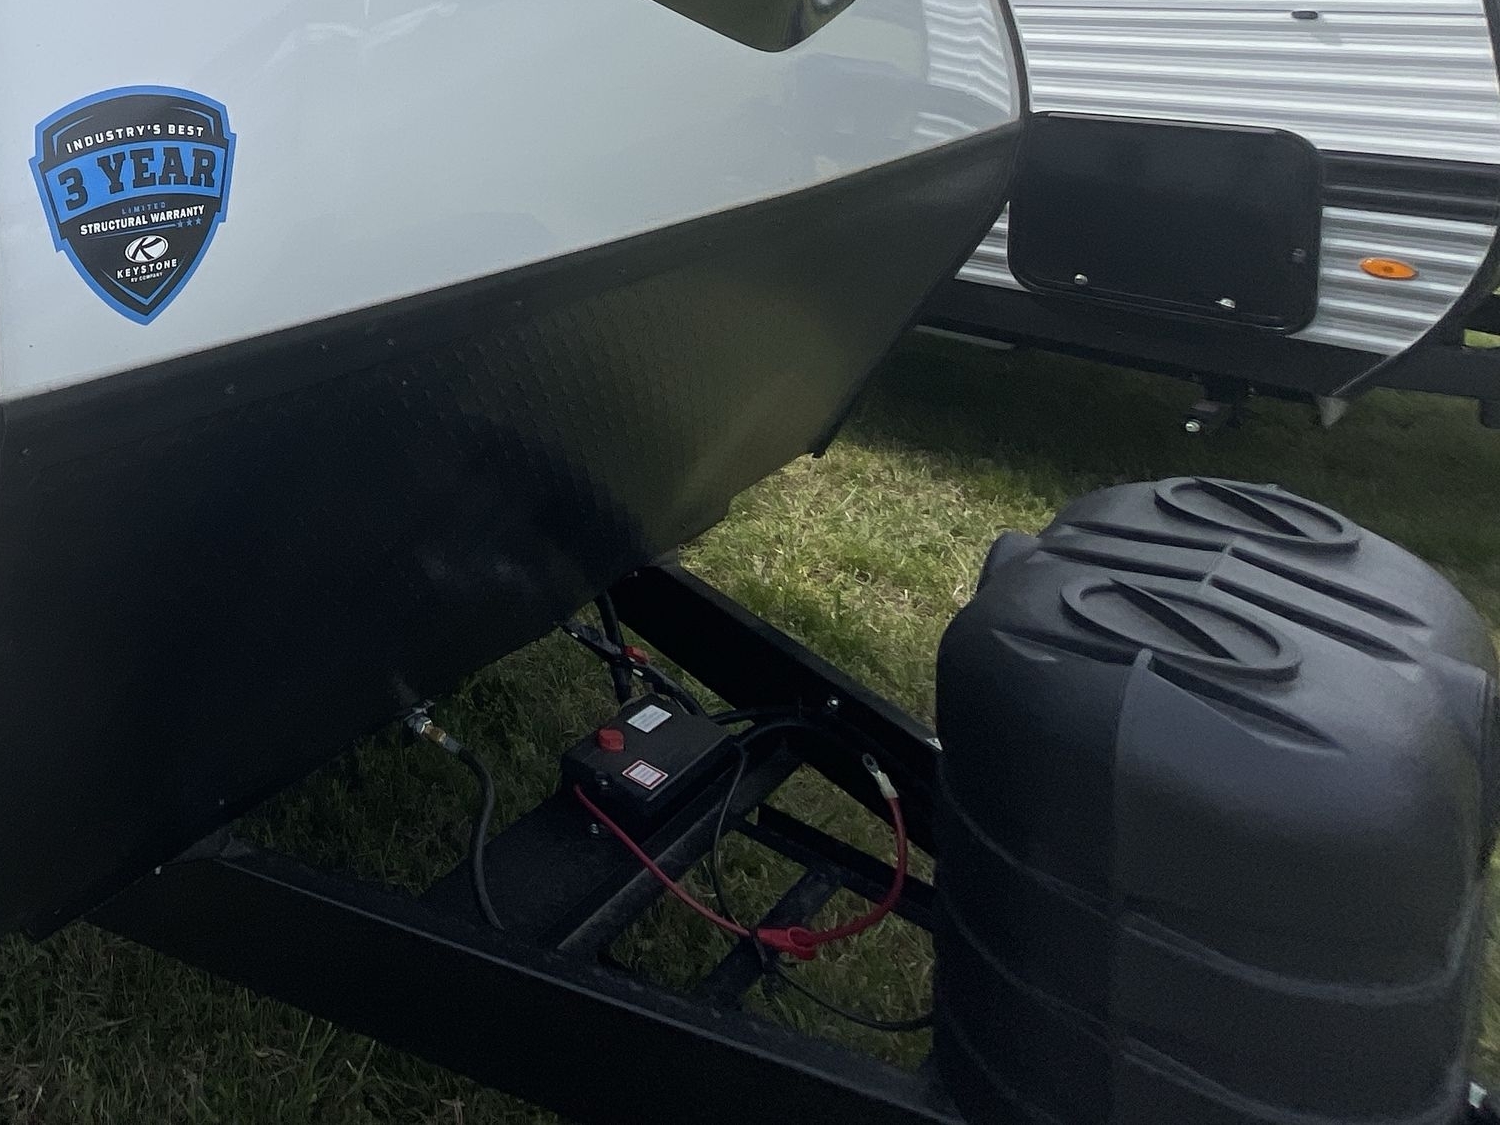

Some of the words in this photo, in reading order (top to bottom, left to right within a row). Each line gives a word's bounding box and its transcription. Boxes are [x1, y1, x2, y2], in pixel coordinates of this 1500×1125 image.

[66, 124, 161, 153] INDUSTRY'S
[168, 124, 204, 137] BEST
[58, 167, 88, 211] 3
[97, 147, 217, 194] YEAR
[80, 215, 148, 236] STRUCTURAL
[150, 204, 205, 223] WARRANTY
[121, 201, 166, 215] LIMITED
[117, 258, 177, 279] KEYSTONE
